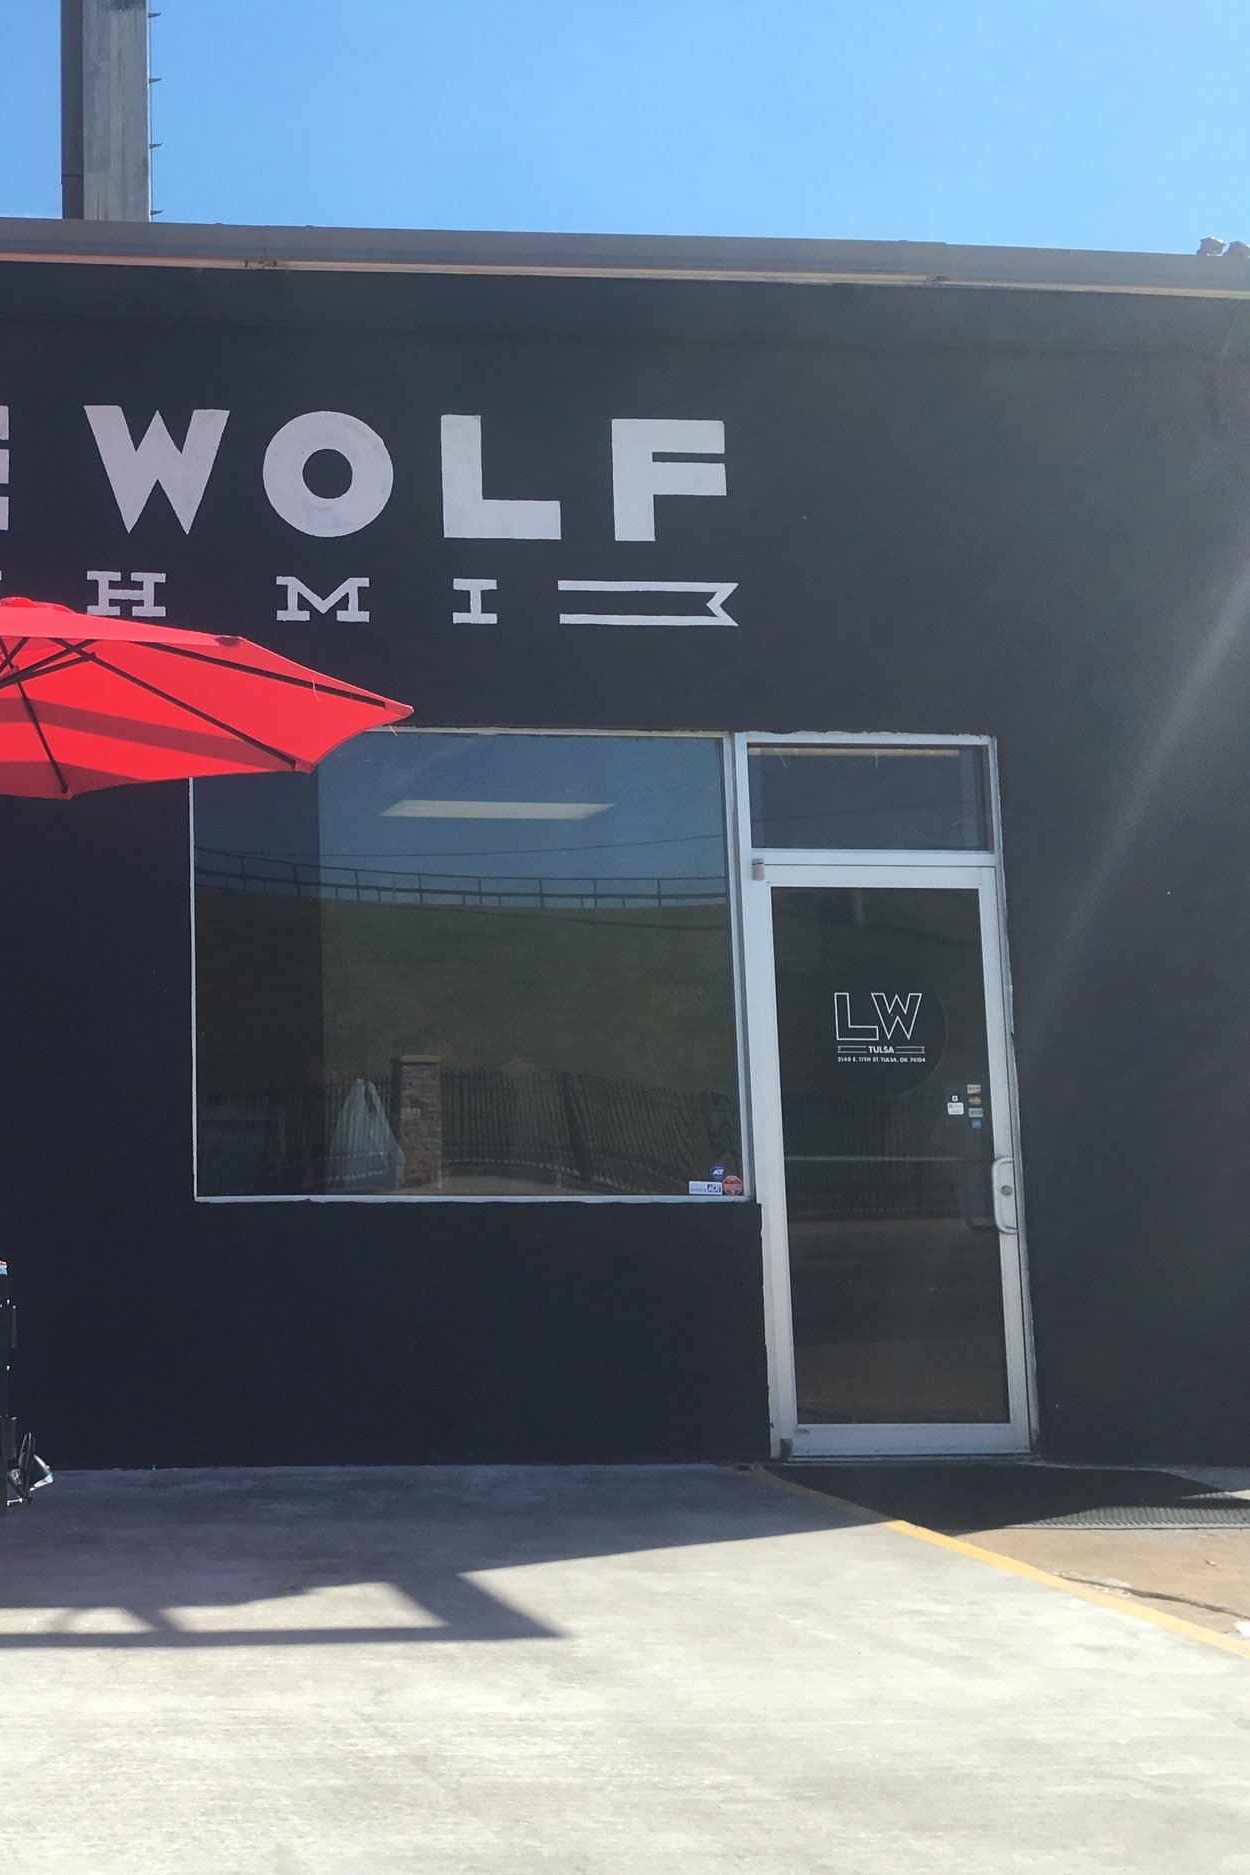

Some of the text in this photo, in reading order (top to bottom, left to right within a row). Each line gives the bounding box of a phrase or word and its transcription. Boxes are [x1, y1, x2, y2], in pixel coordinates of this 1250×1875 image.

[276, 576, 497, 624] MI
[834, 992, 923, 1040] LW
[868, 1046, 895, 1054] TULSA
